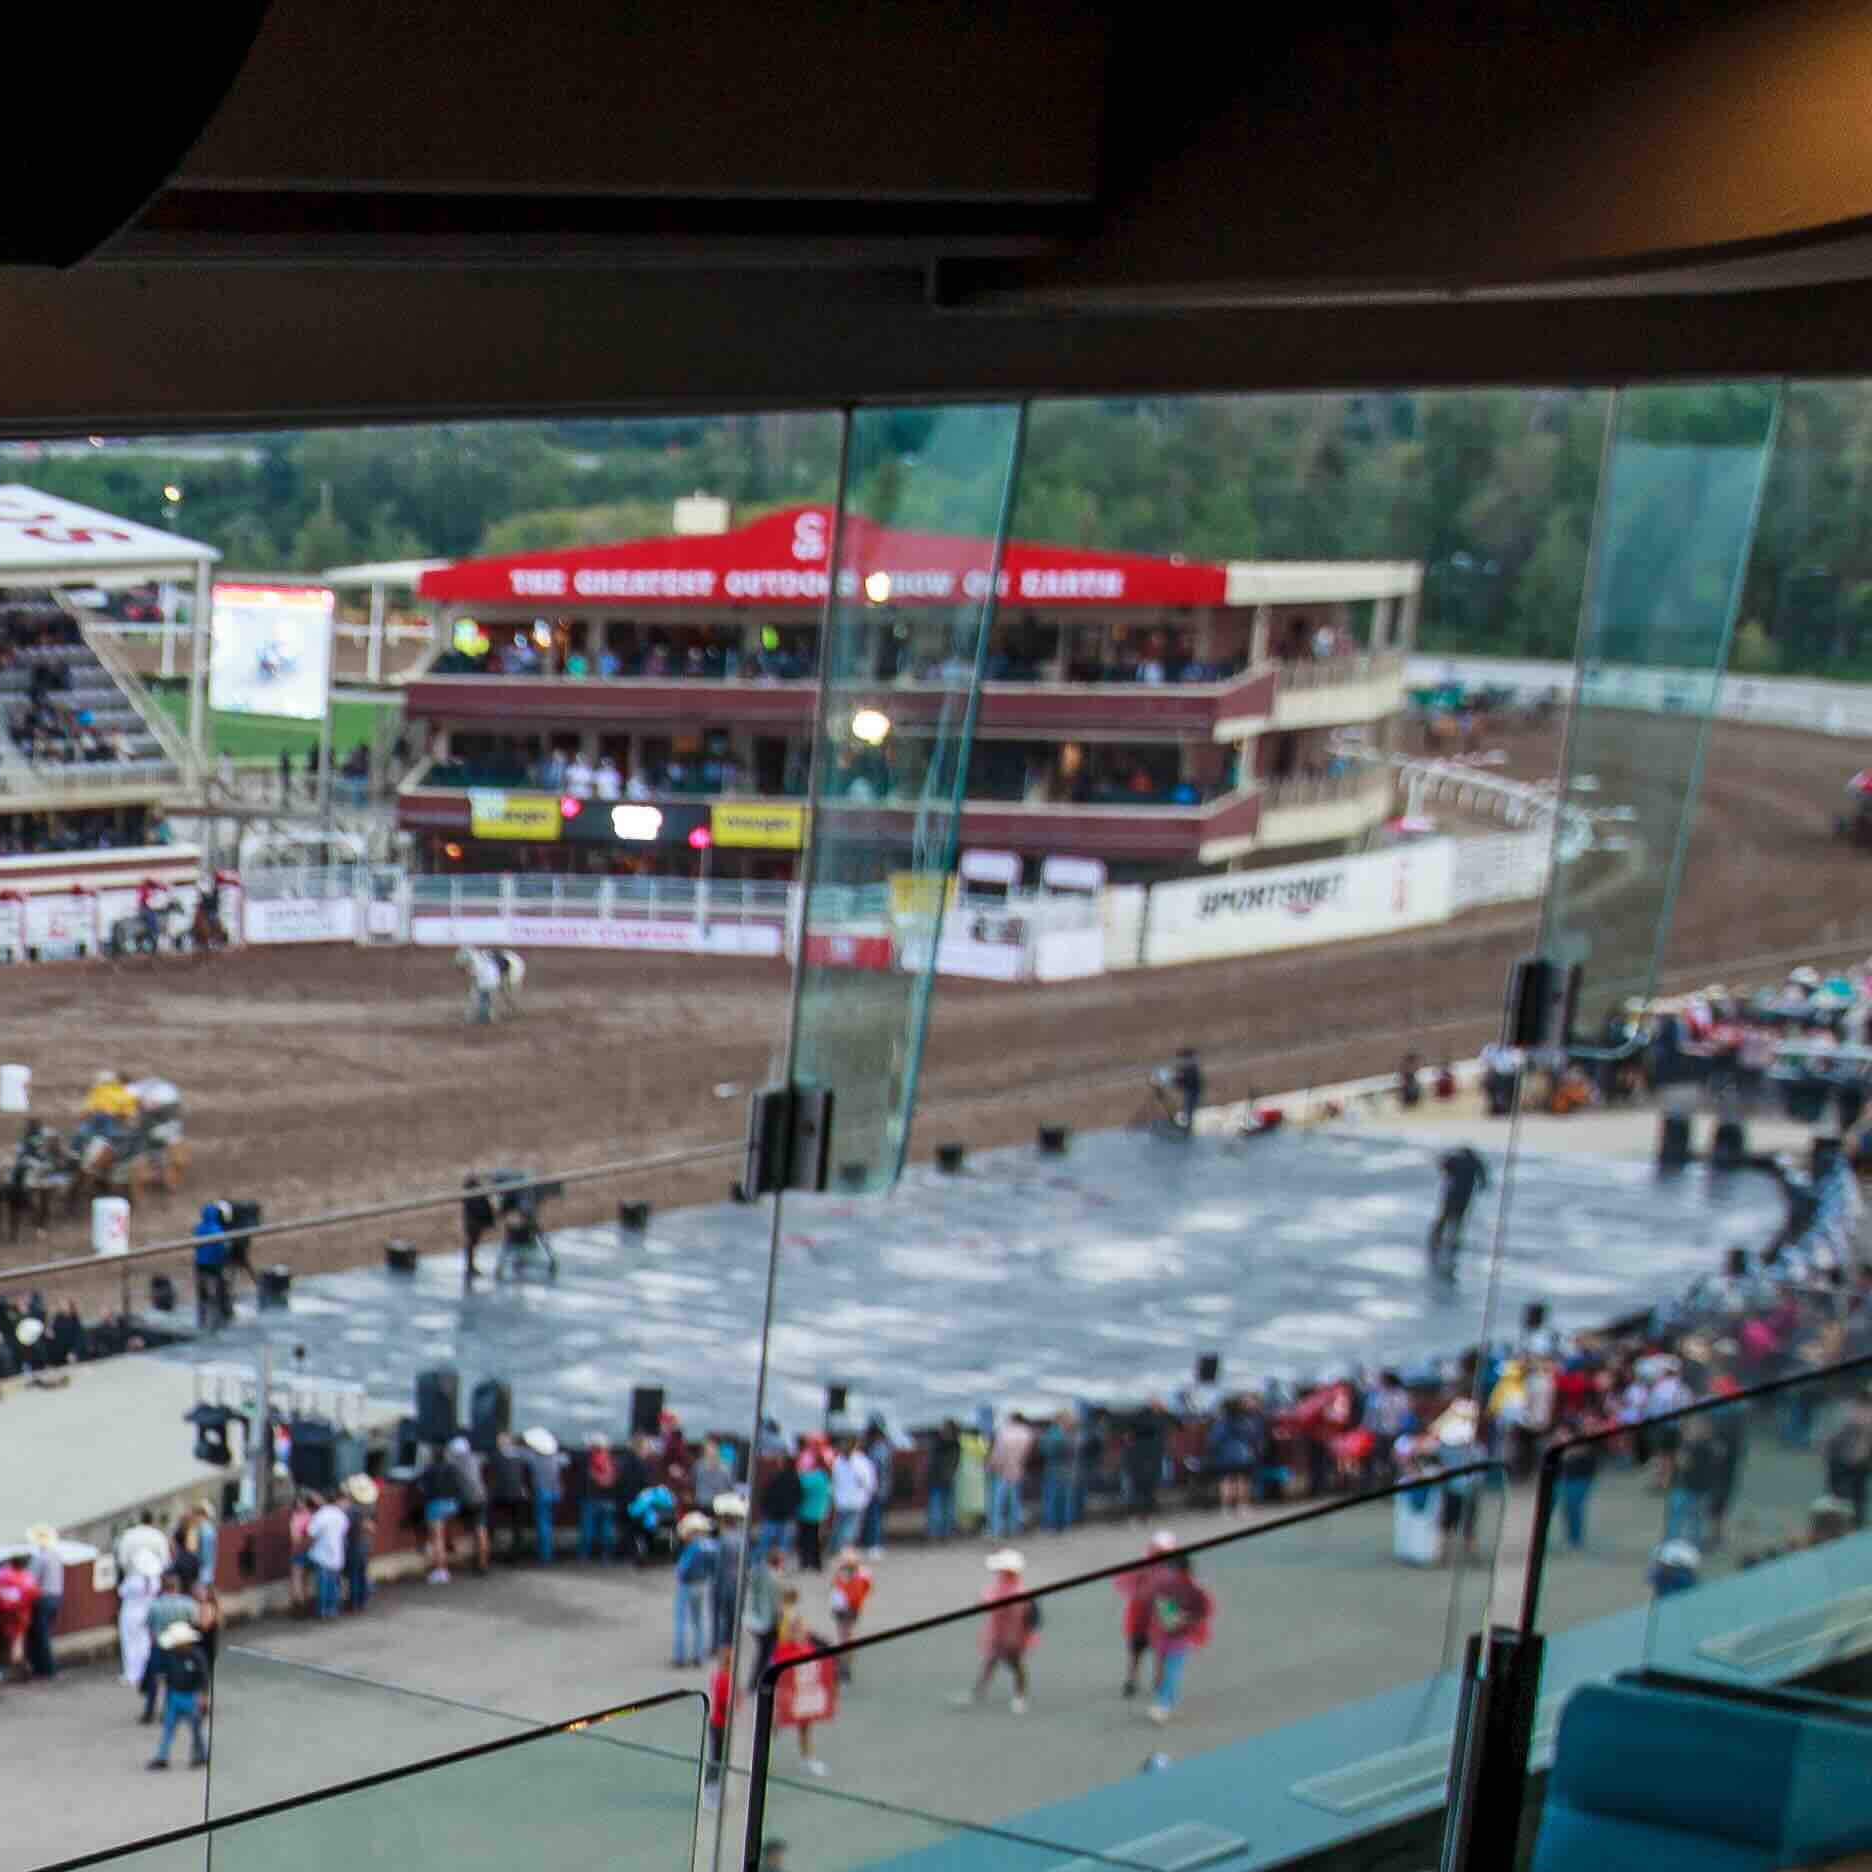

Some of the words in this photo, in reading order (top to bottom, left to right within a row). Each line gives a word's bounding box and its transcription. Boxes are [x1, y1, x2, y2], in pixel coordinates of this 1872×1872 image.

[510, 568, 566, 597] THE
[574, 567, 717, 597] GREATEST
[1021, 566, 1123, 598] EARTH
